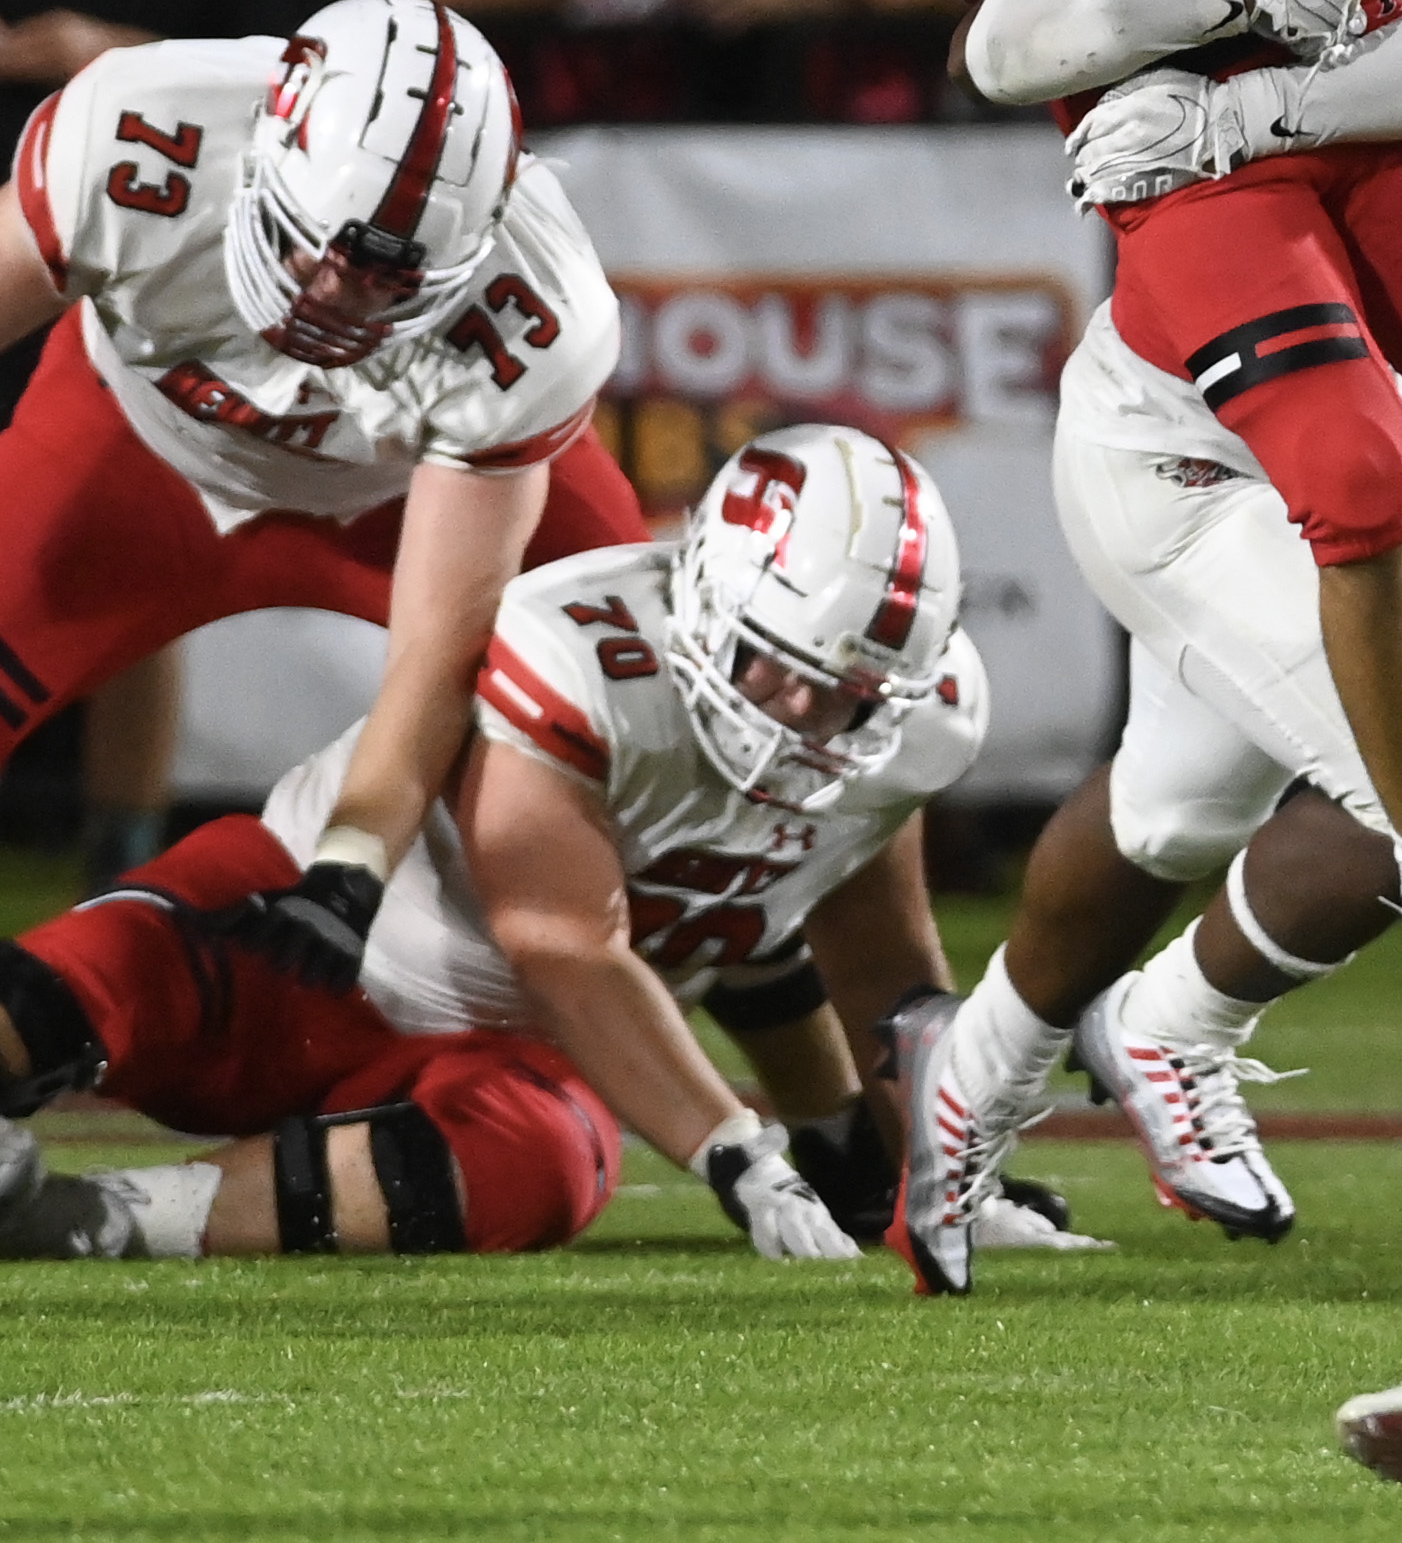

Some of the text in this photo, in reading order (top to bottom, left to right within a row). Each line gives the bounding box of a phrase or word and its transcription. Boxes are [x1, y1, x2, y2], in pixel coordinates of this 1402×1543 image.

[106, 110, 203, 218] 73
[447, 273, 562, 391] 73
[559, 594, 659, 681] 70
